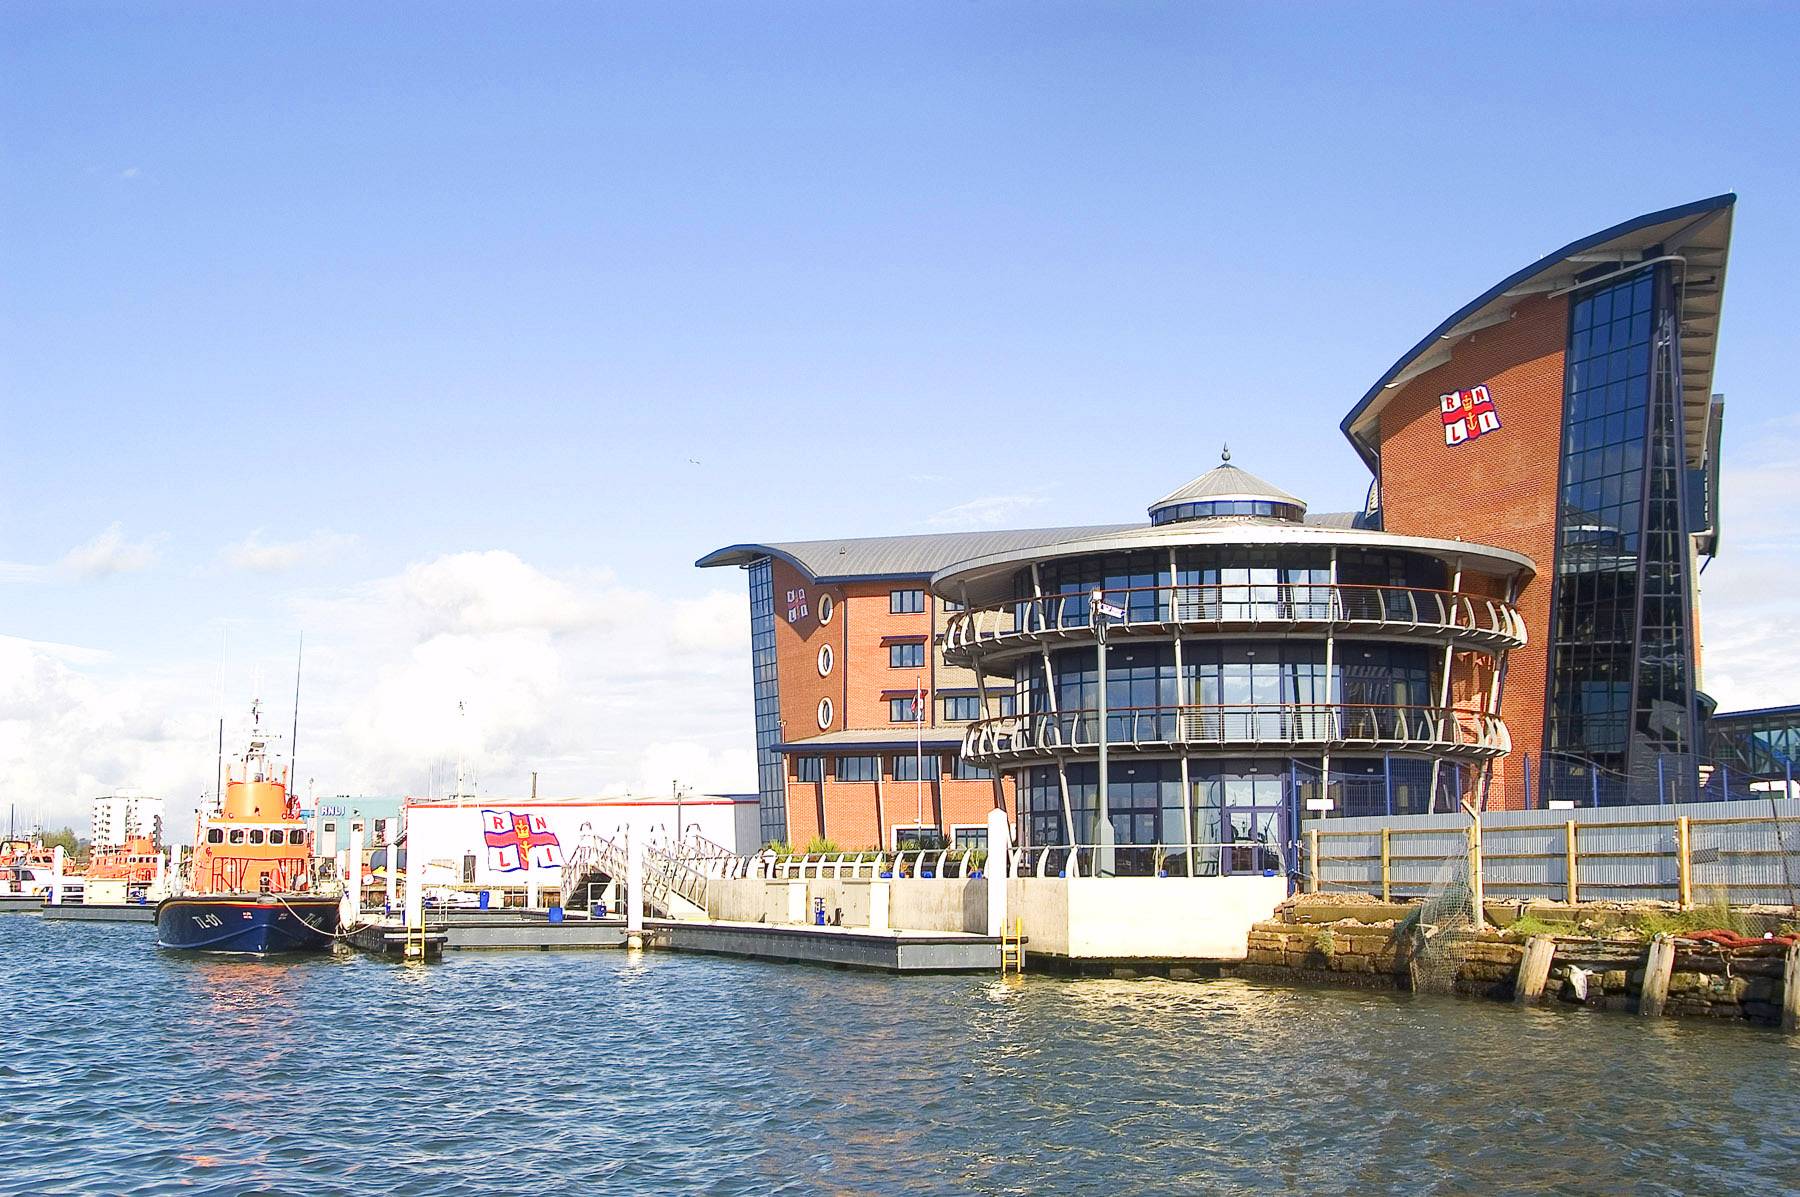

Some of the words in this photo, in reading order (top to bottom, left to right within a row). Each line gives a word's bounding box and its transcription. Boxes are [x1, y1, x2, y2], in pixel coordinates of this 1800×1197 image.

[1446, 396, 1454, 409] R
[1475, 388, 1484, 401] N
[1452, 426, 1460, 441] L
[493, 816, 504, 829] R
[536, 817, 546, 829] N
[499, 851, 510, 867] L
[192, 913, 223, 929] TL-01
